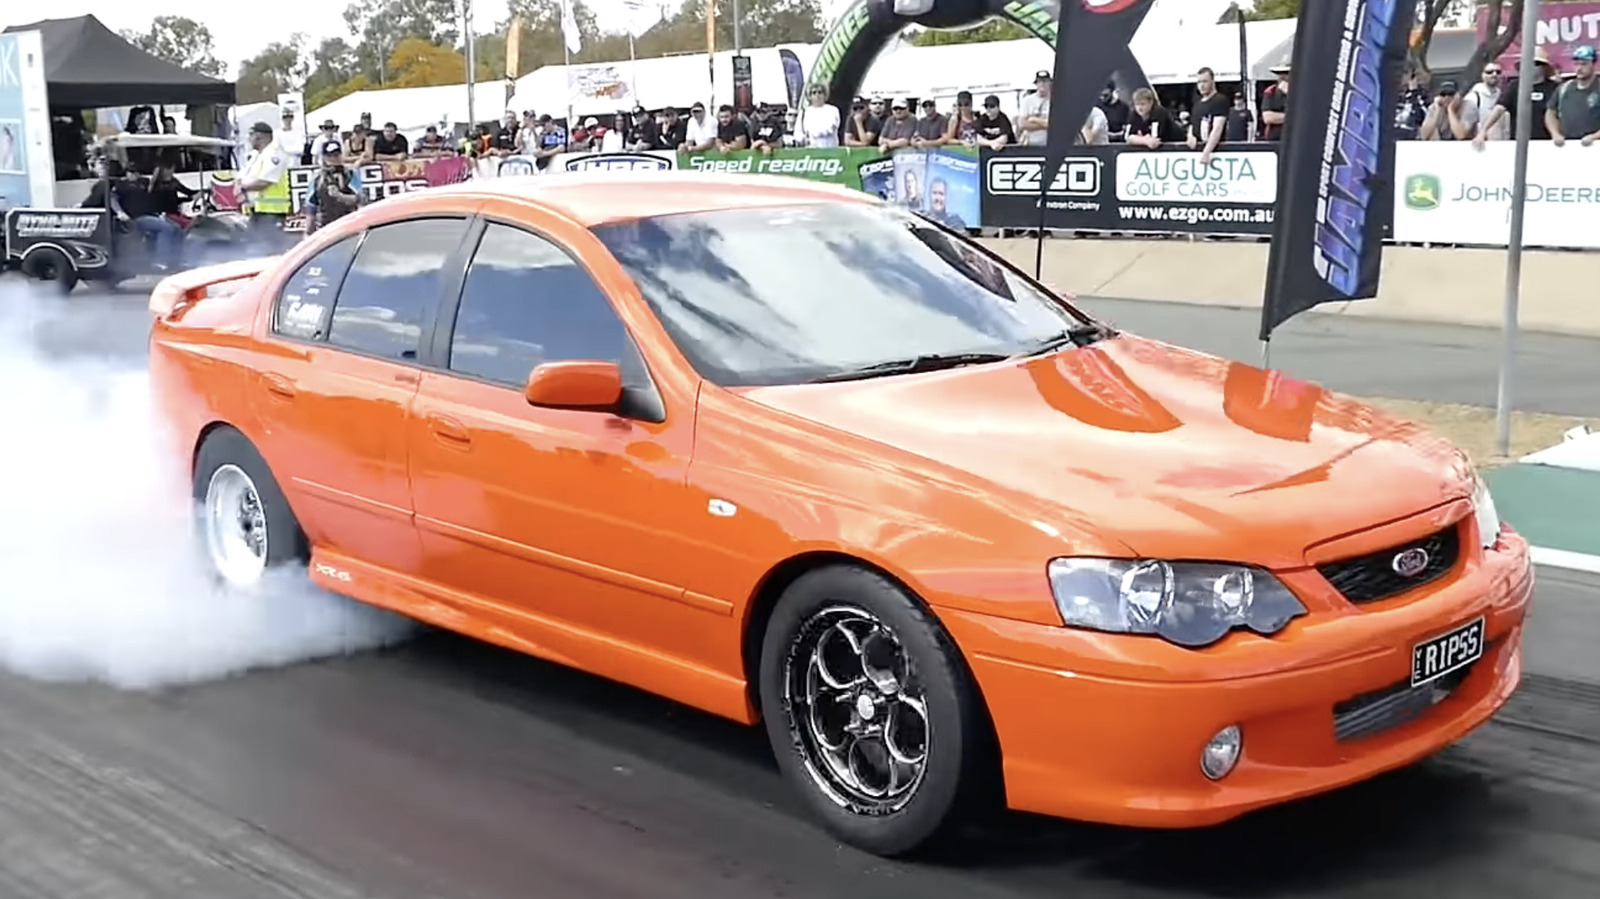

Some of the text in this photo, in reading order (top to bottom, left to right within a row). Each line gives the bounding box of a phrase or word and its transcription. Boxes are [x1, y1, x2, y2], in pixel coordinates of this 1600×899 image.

[690, 155, 844, 176] Speed reading.
[1134, 157, 1256, 181] AUGUSTA
[1125, 181, 1170, 196] GOLF
[1177, 182, 1229, 197] CARS
[1068, 201, 1100, 211] Company
[1118, 206, 1275, 224] www.ezgo.com.au
